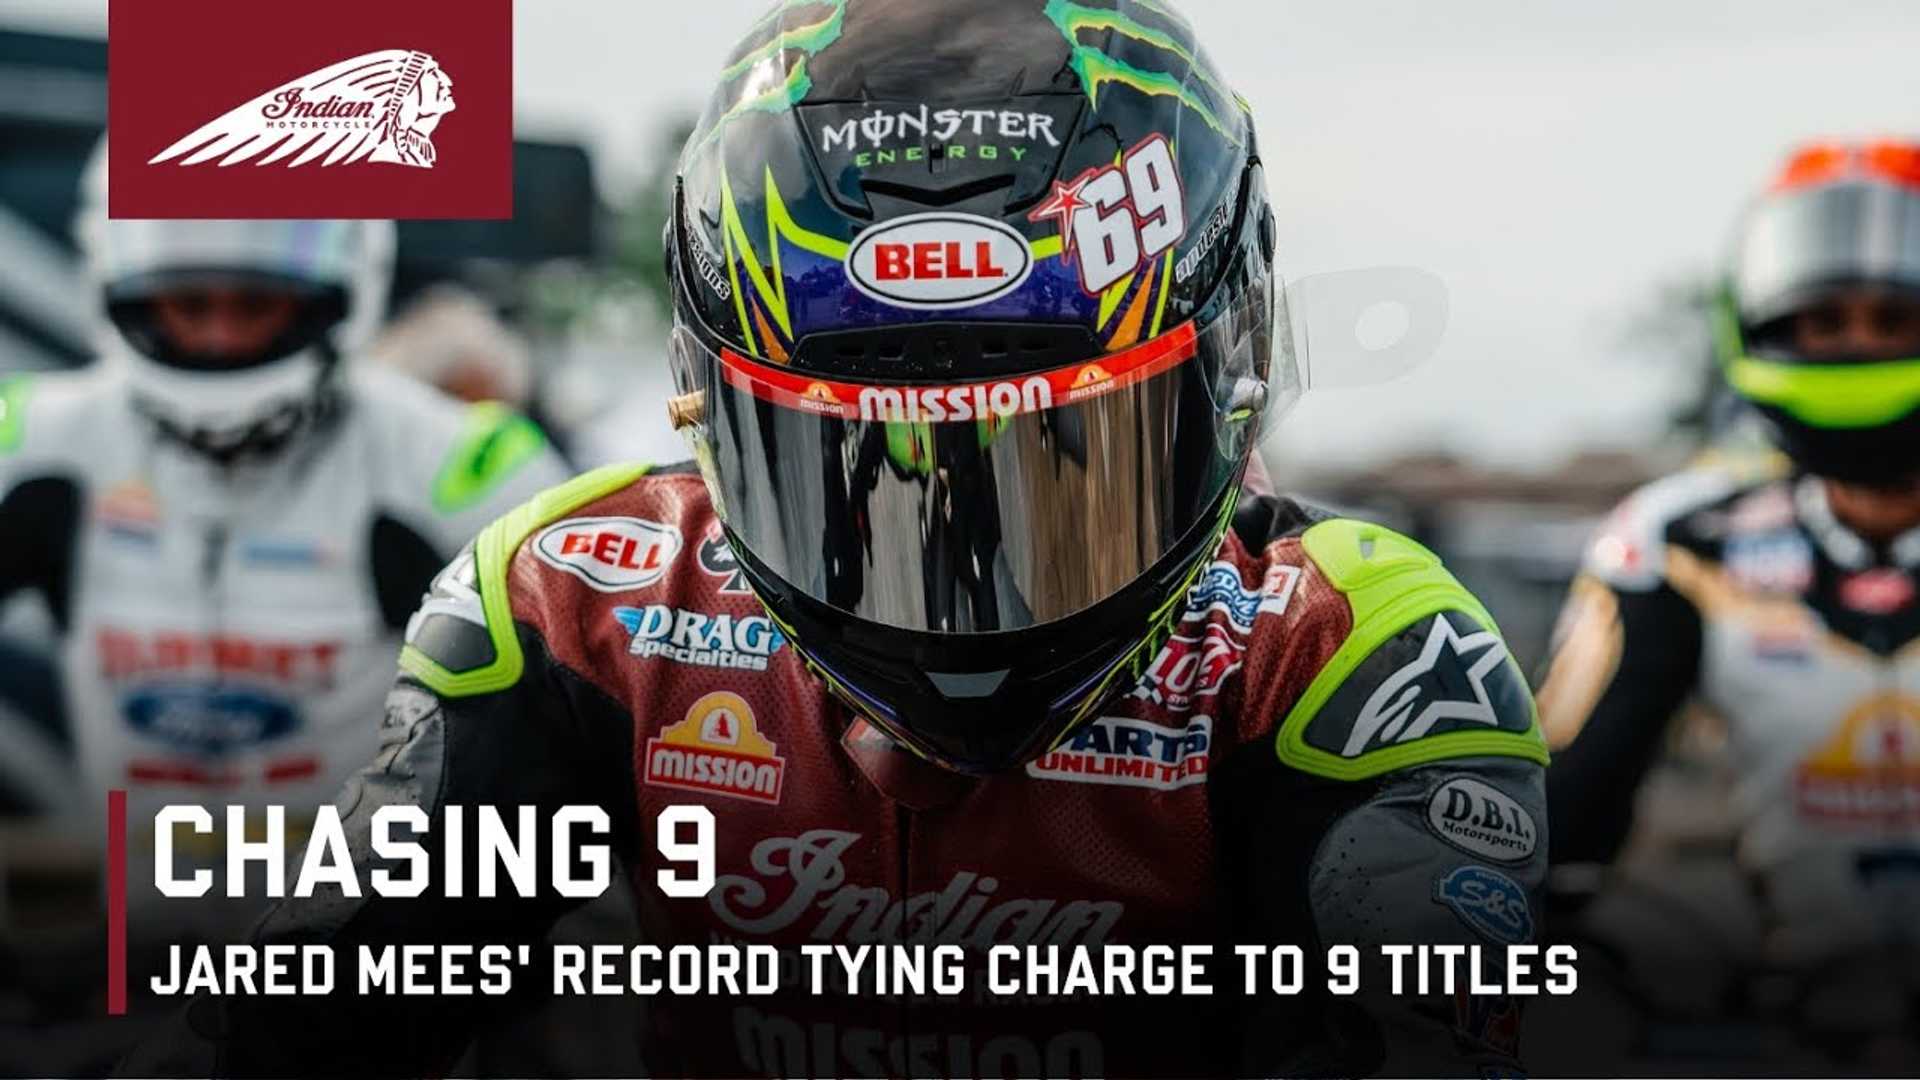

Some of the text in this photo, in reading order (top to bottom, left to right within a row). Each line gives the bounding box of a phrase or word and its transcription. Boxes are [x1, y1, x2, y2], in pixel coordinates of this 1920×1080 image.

[822, 104, 1061, 152] MONSTER
[855, 145, 1027, 168] ENERGY
[1071, 137, 1184, 295] 69
[874, 240, 1008, 281] BELL
[859, 376, 1051, 422] MISSION
[560, 531, 662, 571] BELL
[635, 605, 776, 656] DRAG
[629, 637, 769, 671] Specialties
[652, 749, 776, 794] MISSION
[1036, 752, 1208, 782] UNLIMITED
[1442, 786, 1530, 839] D.B.I.
[1443, 821, 1528, 852] Motorsports
[708, 829, 1125, 946] Indian
[1460, 879, 1525, 929] S&S
